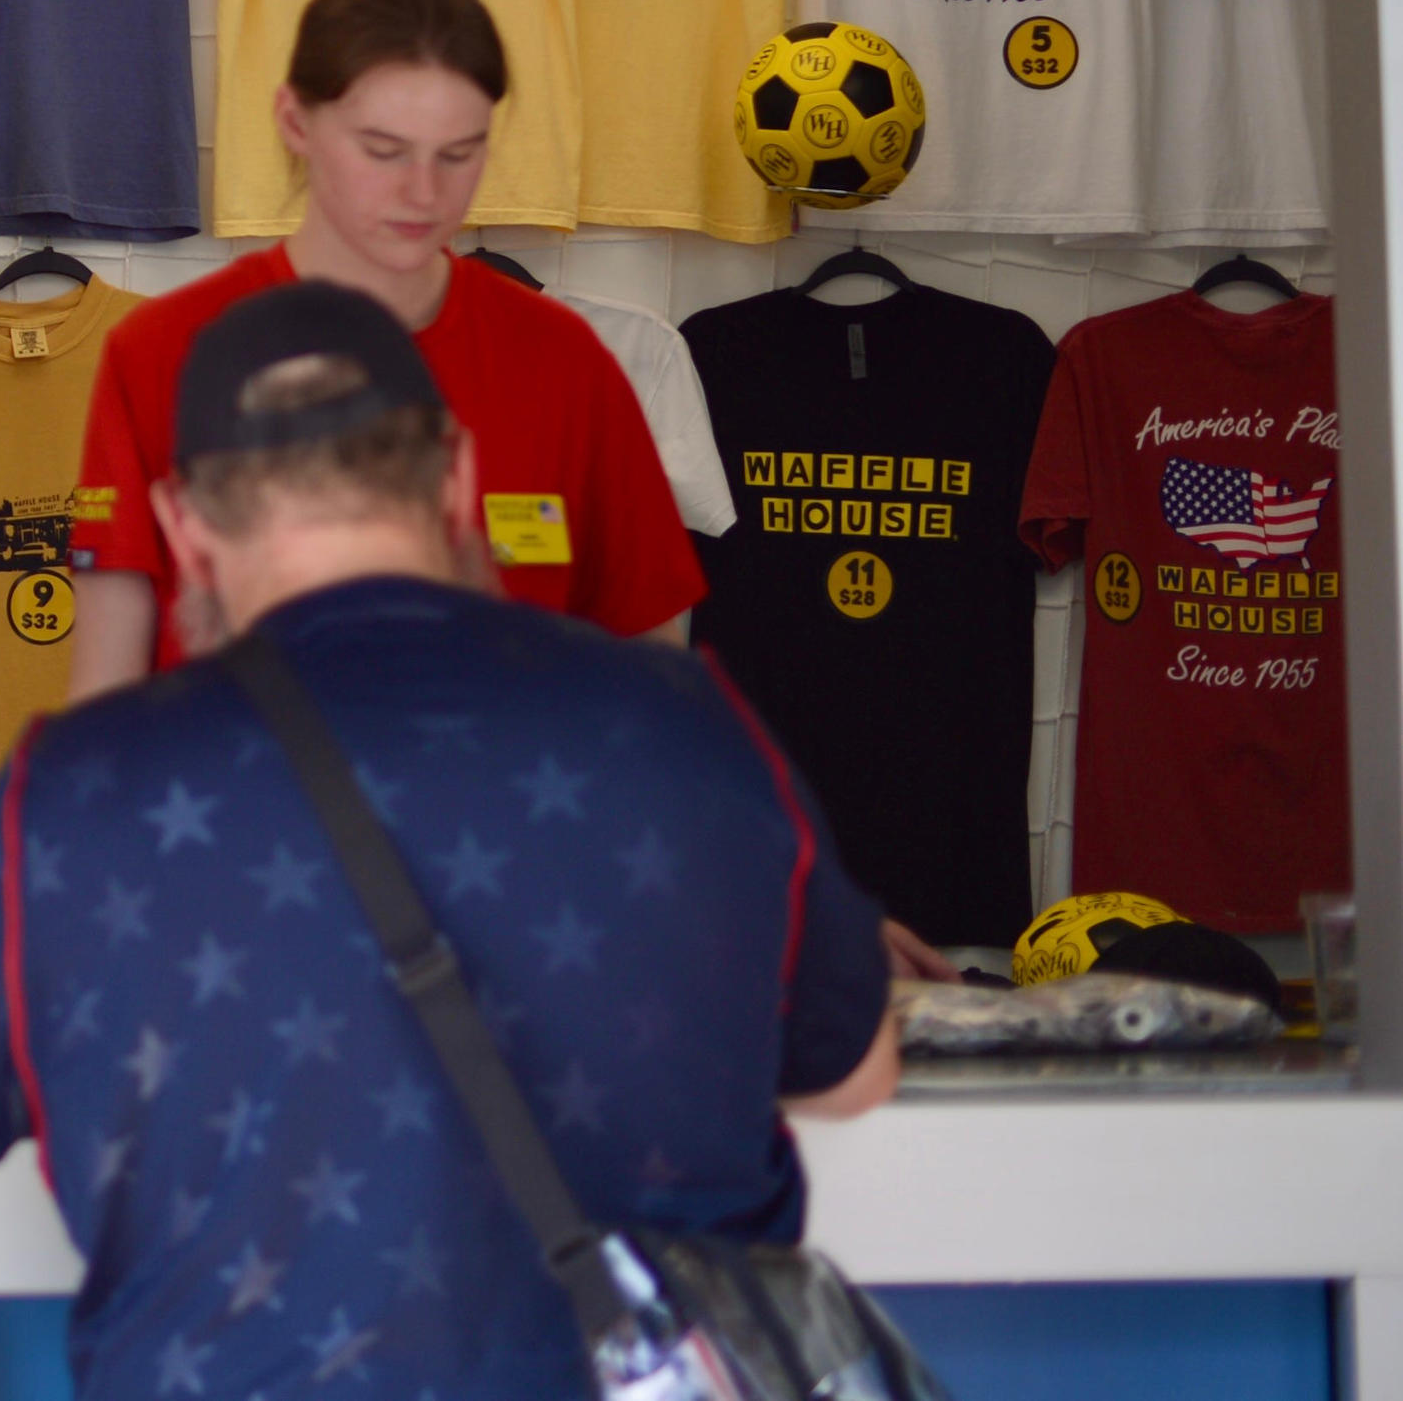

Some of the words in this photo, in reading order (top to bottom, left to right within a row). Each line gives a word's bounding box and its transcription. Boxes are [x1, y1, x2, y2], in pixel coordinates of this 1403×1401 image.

[1032, 26, 1052, 52] 5
[1021, 58, 1058, 77] $32
[810, 111, 843, 140] WH
[1136, 405, 1274, 451] America's
[747, 453, 968, 493] WAFFLE
[766, 500, 951, 537] HOUSE
[846, 560, 875, 583] 11
[1105, 553, 1130, 587] 12
[1159, 565, 1337, 597] WAFFLE
[32, 581, 53, 608] 9
[839, 589, 875, 606] $28
[1105, 589, 1131, 609] $32
[21, 613, 57, 631] $32
[1176, 605, 1322, 633] HOUSE
[1167, 645, 1247, 689] Since
[1256, 657, 1316, 690] 1955
